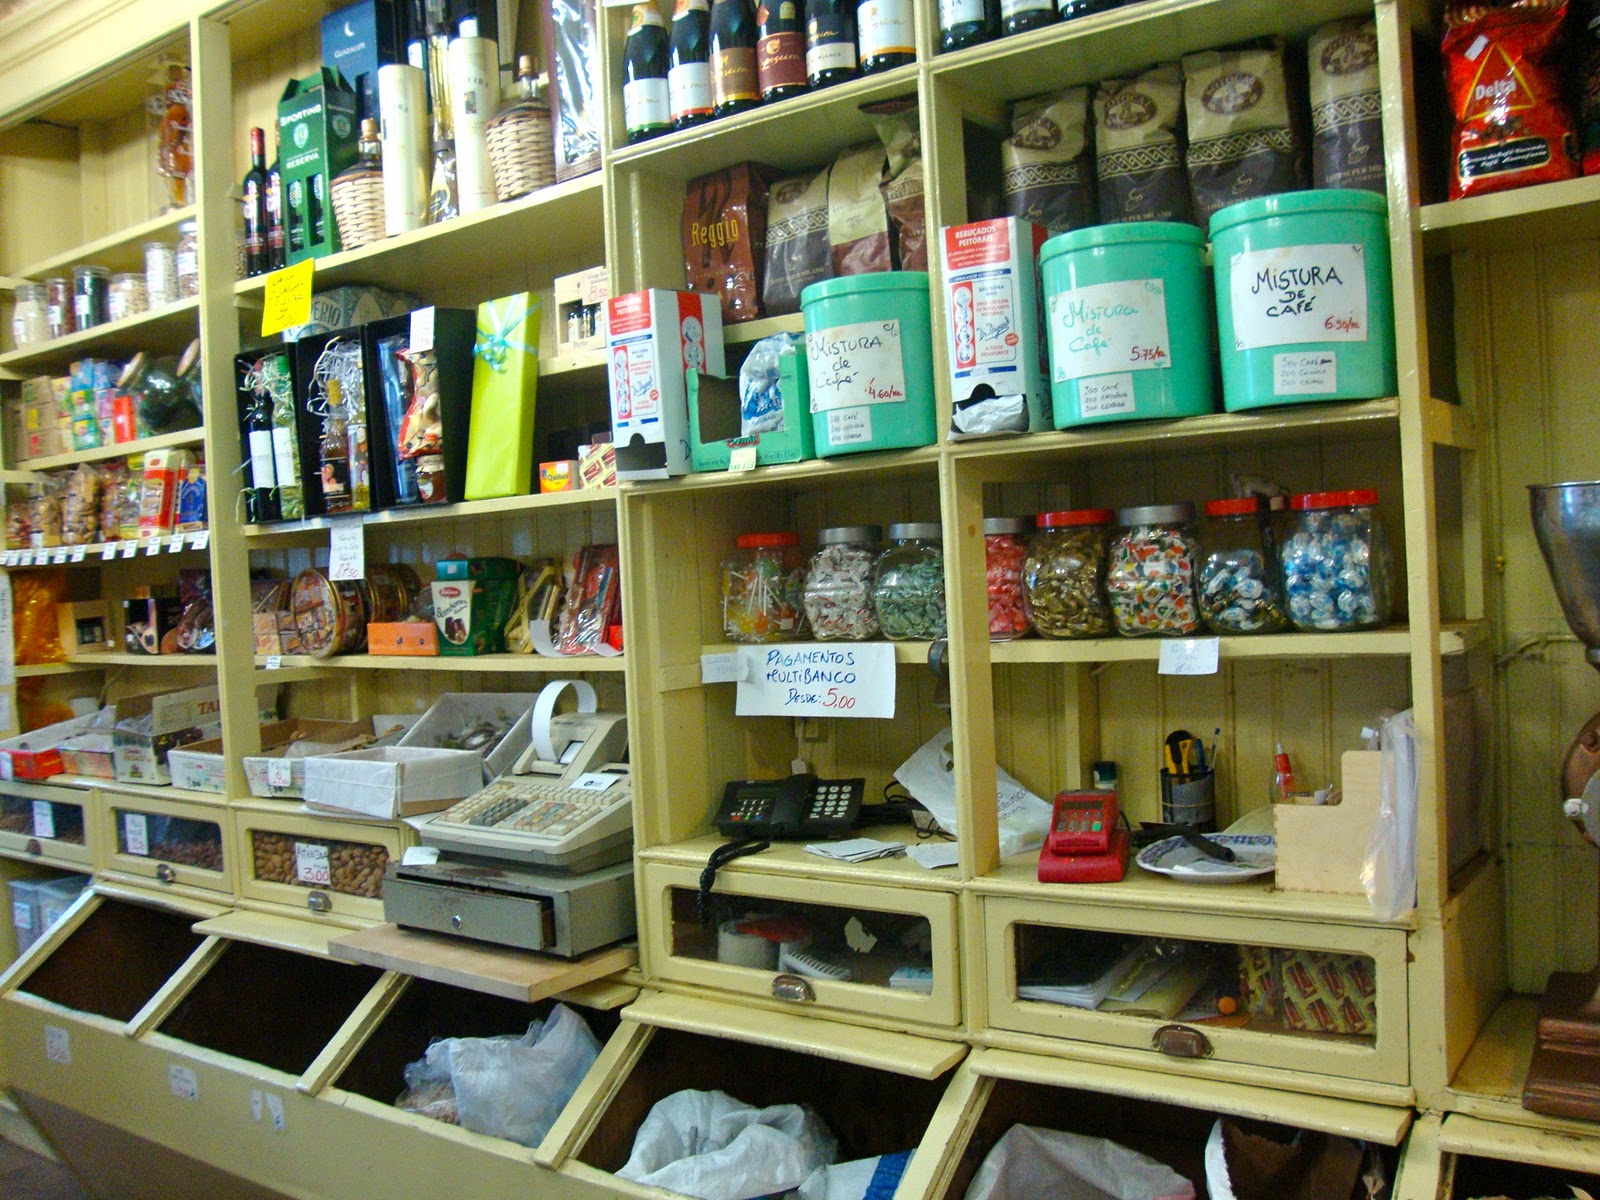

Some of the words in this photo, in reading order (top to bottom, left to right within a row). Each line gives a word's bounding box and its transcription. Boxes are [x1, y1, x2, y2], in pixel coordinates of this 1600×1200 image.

[1475, 79, 1516, 100] Delta
[280, 104, 322, 127] SPORTING
[286, 152, 320, 170] RESERVA
[692, 219, 739, 248] Reggio
[955, 225, 997, 239] REBUÇADOS
[958, 234, 994, 247] PEITORAIS
[1279, 289, 1306, 303] DE
[1266, 296, 1316, 318] CAFÉ
[1085, 324, 1102, 336] de
[833, 356, 851, 372] de
[766, 649, 855, 667] PAGAMENTOS
[822, 687, 856, 709] 5,00
